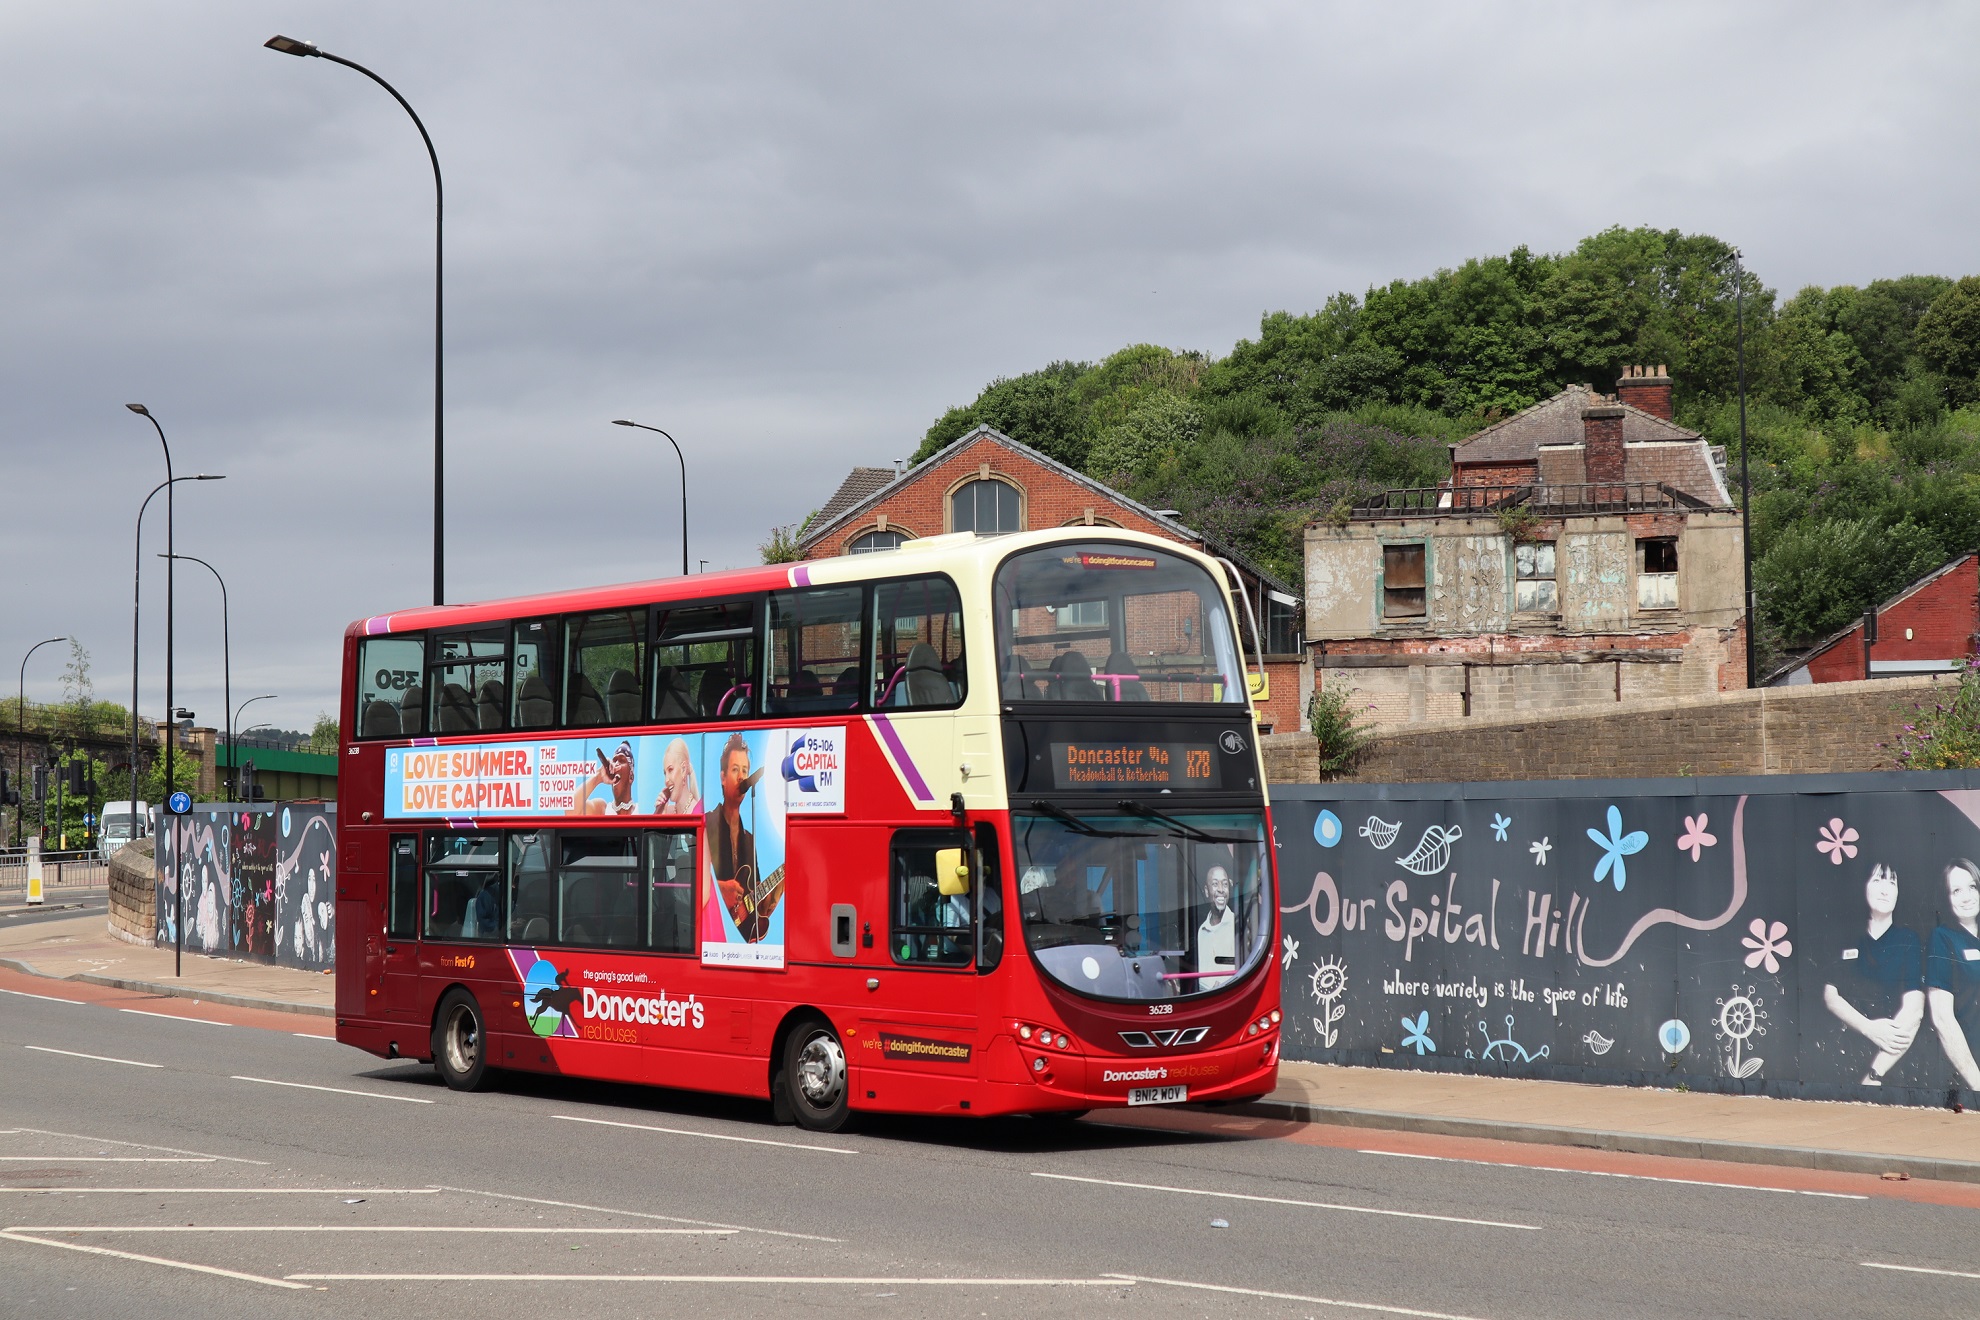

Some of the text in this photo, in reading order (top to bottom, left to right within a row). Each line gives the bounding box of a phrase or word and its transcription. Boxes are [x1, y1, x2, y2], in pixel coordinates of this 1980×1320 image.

[1062, 556, 1082, 564] we're
[807, 738, 834, 752] 95-106
[540, 748, 556, 760] THE
[797, 753, 838, 770] CAPITAL
[1067, 746, 1143, 765] Doncaster
[404, 750, 532, 779] LOVE SUMMER.
[540, 763, 596, 776] SOUNDTRACK
[1186, 750, 1211, 778] X78
[819, 771, 833, 787] FM
[1069, 767, 1169, 782] Meadowhall & Rotherham
[540, 779, 575, 792] TO YOUR
[404, 782, 532, 810] LOVE CAPITAL.
[539, 796, 573, 808] SUMMER
[1308, 871, 1606, 968] Our Spital Hill
[440, 955, 467, 968] from First
[583, 969, 594, 979] the
[594, 970, 616, 983] going's
[616, 972, 634, 984] good
[1383, 969, 1629, 1016] where variety is the spice of life
[583, 987, 705, 1029] Doncaster's
[1149, 1004, 1173, 1015] 36238
[583, 1022, 637, 1043] red buses
[862, 1038, 969, 1058] we're #doingitfordoncaster
[1103, 1065, 1220, 1082] Doncaster's red buses
[1134, 1087, 1181, 1103] BN12 WOV
